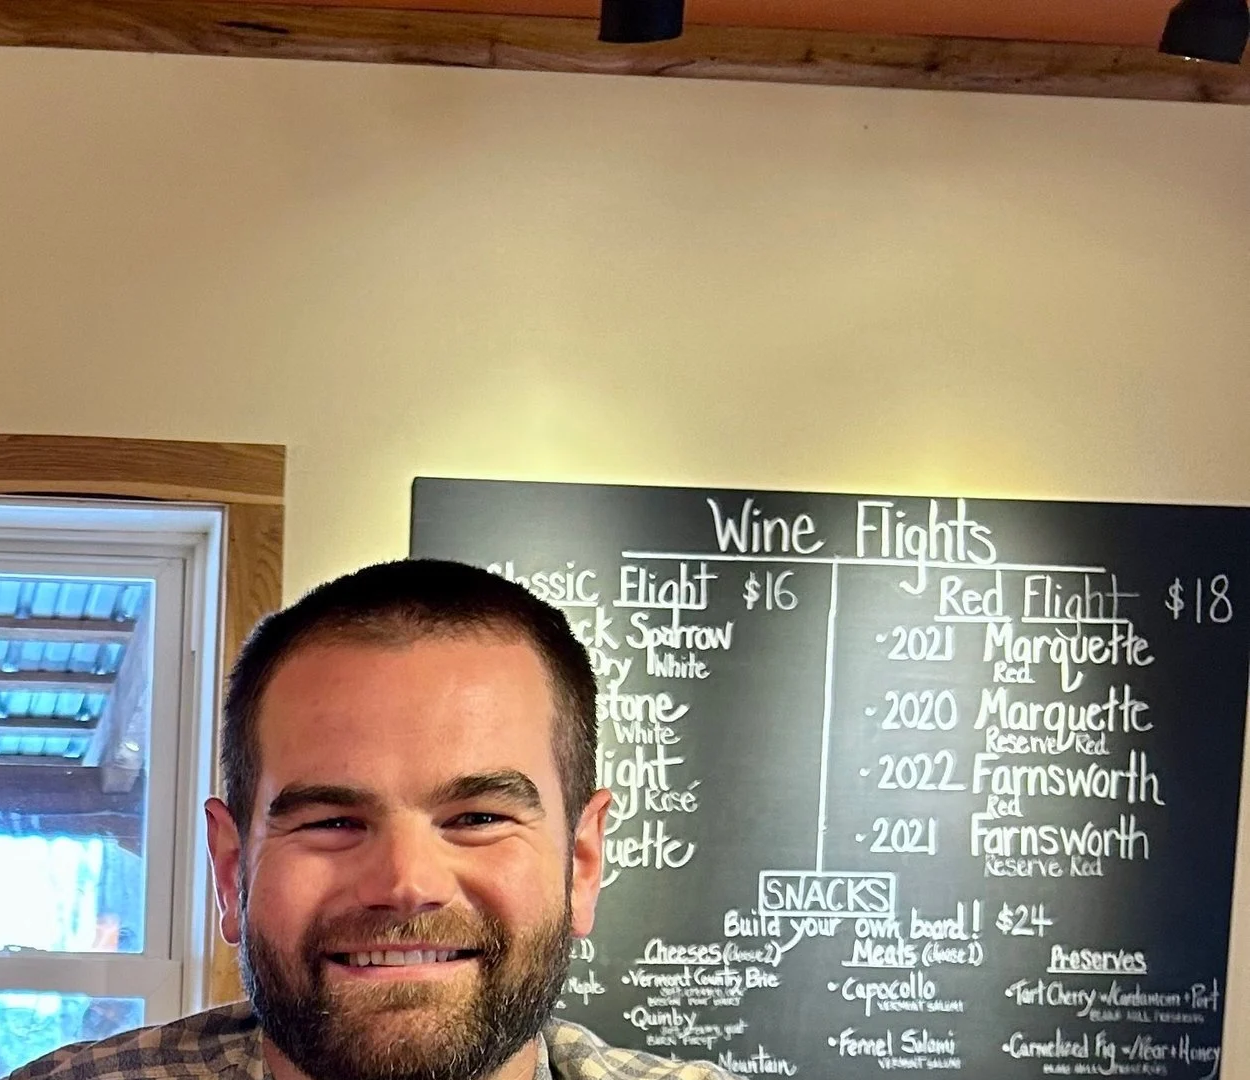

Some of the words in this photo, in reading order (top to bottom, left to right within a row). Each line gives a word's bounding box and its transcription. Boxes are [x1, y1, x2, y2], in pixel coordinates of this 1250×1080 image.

[707, 498, 826, 554] Wine
[856, 499, 997, 595] Flights
[620, 562, 718, 630] Flight
[743, 570, 799, 611] $16
[940, 570, 1003, 617] Red
[1023, 574, 1140, 640] Flight
[1166, 574, 1233, 623] $18
[626, 612, 734, 674] Sparrow
[888, 624, 954, 661] 2021
[983, 622, 1154, 692] Marquette
[654, 651, 711, 680] White
[994, 662, 1035, 684] Red
[596, 679, 690, 723] stone
[882, 689, 956, 731] 2020
[974, 684, 1153, 752] Marquette
[613, 721, 682, 745] White
[986, 729, 1058, 754] Reserve
[1074, 734, 1111, 756] Red
[596, 744, 684, 820] light
[878, 750, 965, 791] 2022
[972, 750, 1165, 806] Farnsworth
[986, 796, 1023, 818] Red
[601, 820, 694, 886] uette
[870, 817, 936, 856] 2021
[971, 812, 1150, 860] Farnsworth
[984, 854, 1063, 877] Reserve
[1070, 856, 1103, 877] Red
[763, 877, 891, 912] SNACKS
[724, 908, 781, 938] Build
[781, 916, 841, 953] your
[855, 918, 901, 940] own
[996, 901, 1054, 937] $24
[645, 938, 722, 964] Cheeses
[852, 938, 918, 966] Meats
[1050, 944, 1147, 972] Preserves
[629, 966, 691, 988] Vermont
[745, 966, 781, 989] Brie
[1010, 977, 1047, 1005] Tart
[630, 1005, 696, 1038] Quinby
[839, 1027, 893, 1057] Fennel
